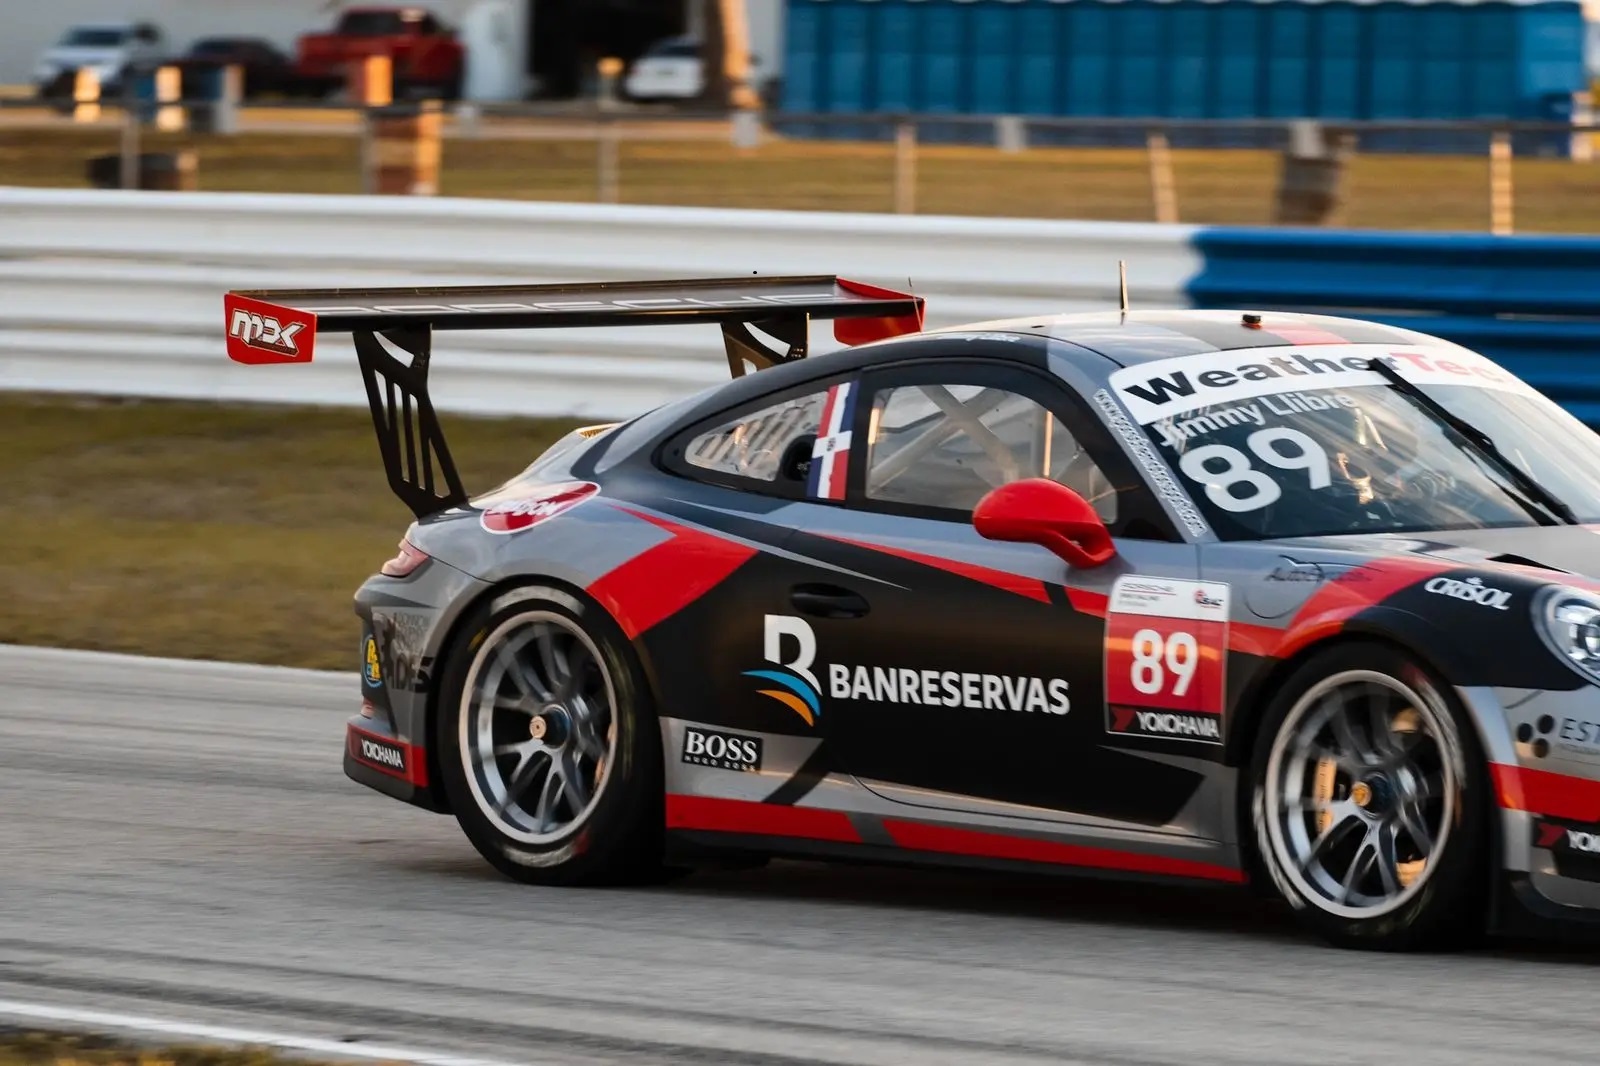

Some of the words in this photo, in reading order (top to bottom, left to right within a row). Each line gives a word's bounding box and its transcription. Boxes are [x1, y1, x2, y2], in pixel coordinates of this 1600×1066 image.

[1151, 402, 1266, 447] Jimmy
[1179, 427, 1332, 513] 89
[1424, 577, 1512, 611] CRISOL
[1130, 629, 1198, 697] 89
[829, 663, 1071, 715] BANRESERVAS
[1136, 711, 1220, 738] YOKOHAMA
[361, 738, 404, 769] YOKOHAMA
[685, 731, 758, 764] BOSS
